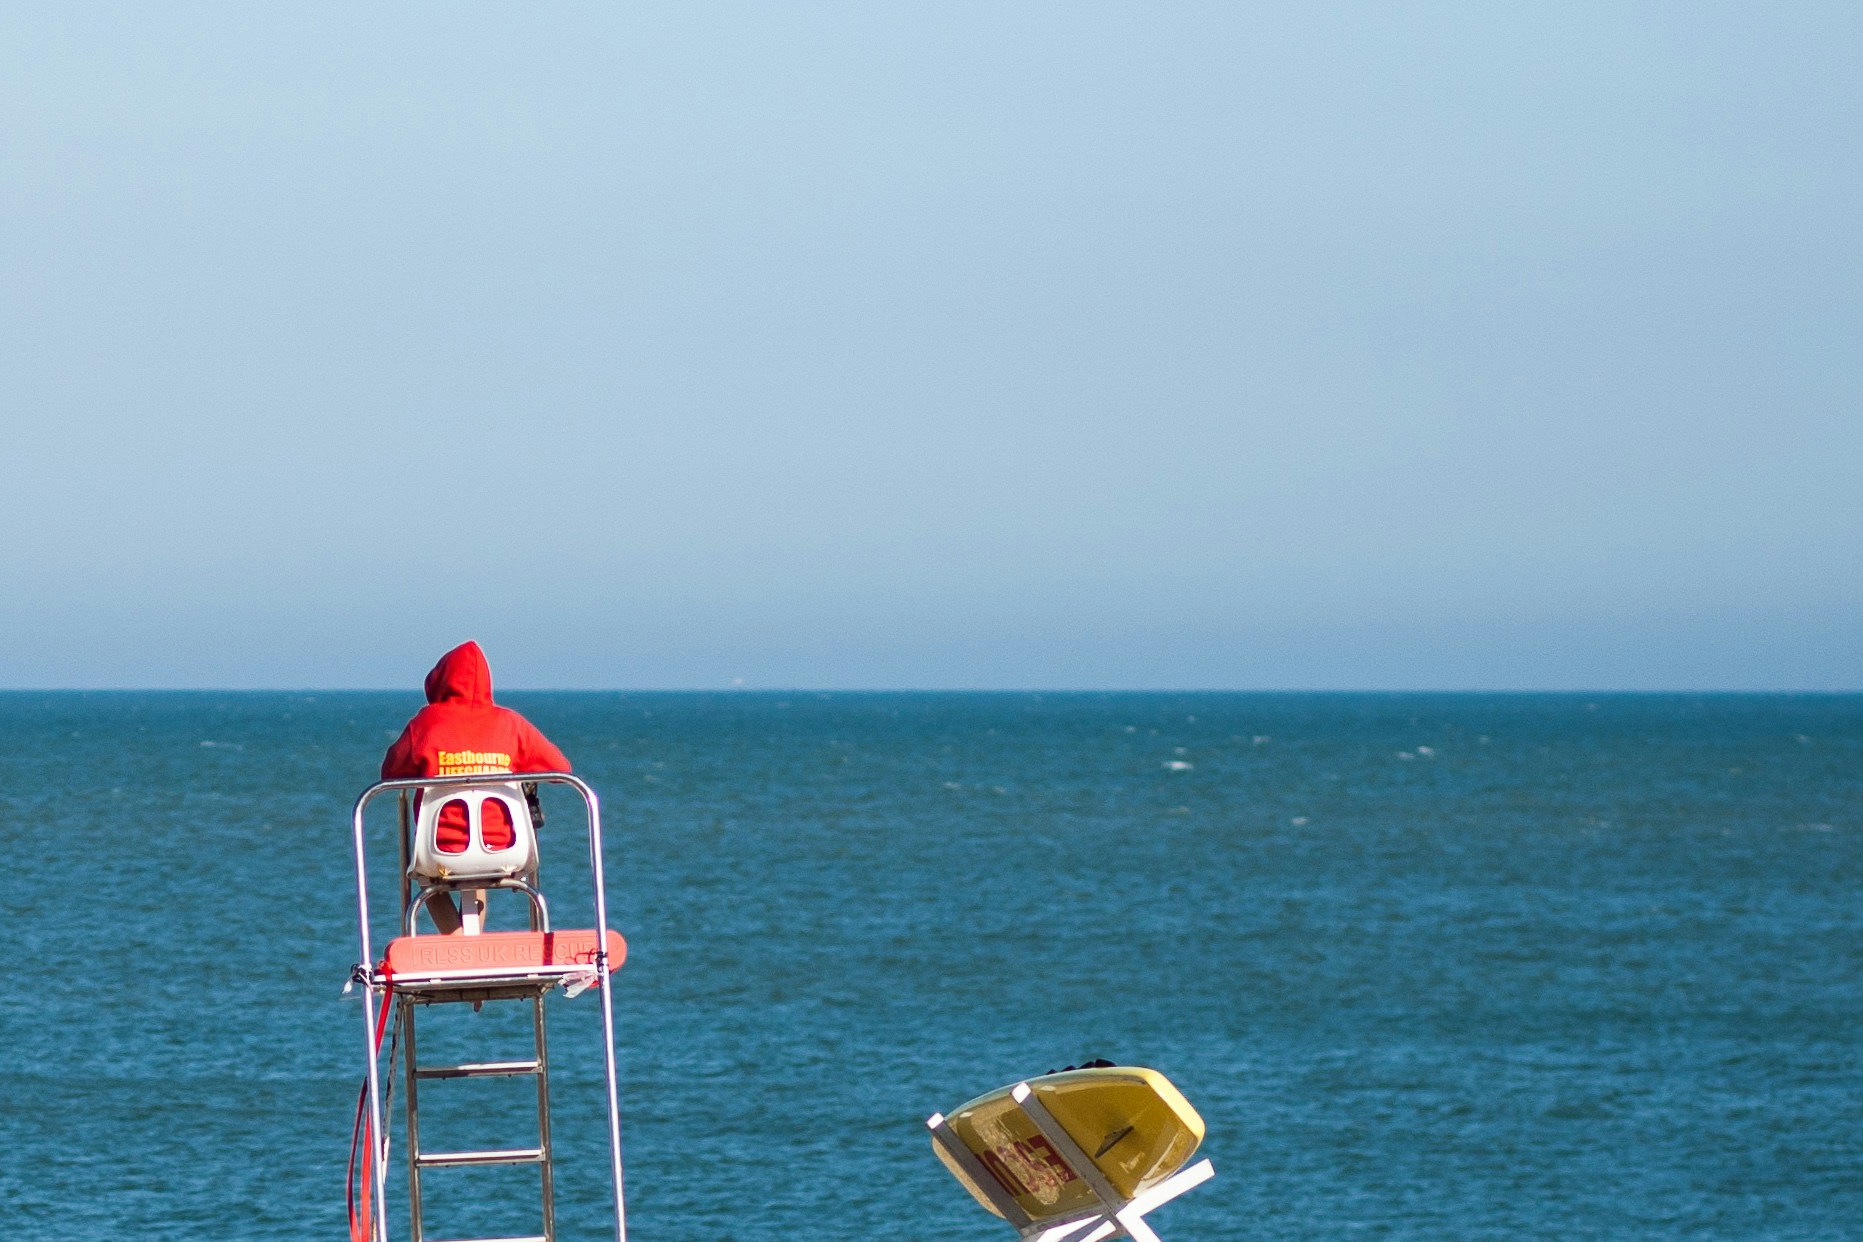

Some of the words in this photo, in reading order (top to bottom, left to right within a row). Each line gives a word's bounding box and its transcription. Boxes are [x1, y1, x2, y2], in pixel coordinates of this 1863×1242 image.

[438, 750, 511, 766] Eastbourne
[421, 945, 471, 965] RLSS
[479, 944, 505, 962] UK
[514, 942, 596, 961] RECUE
